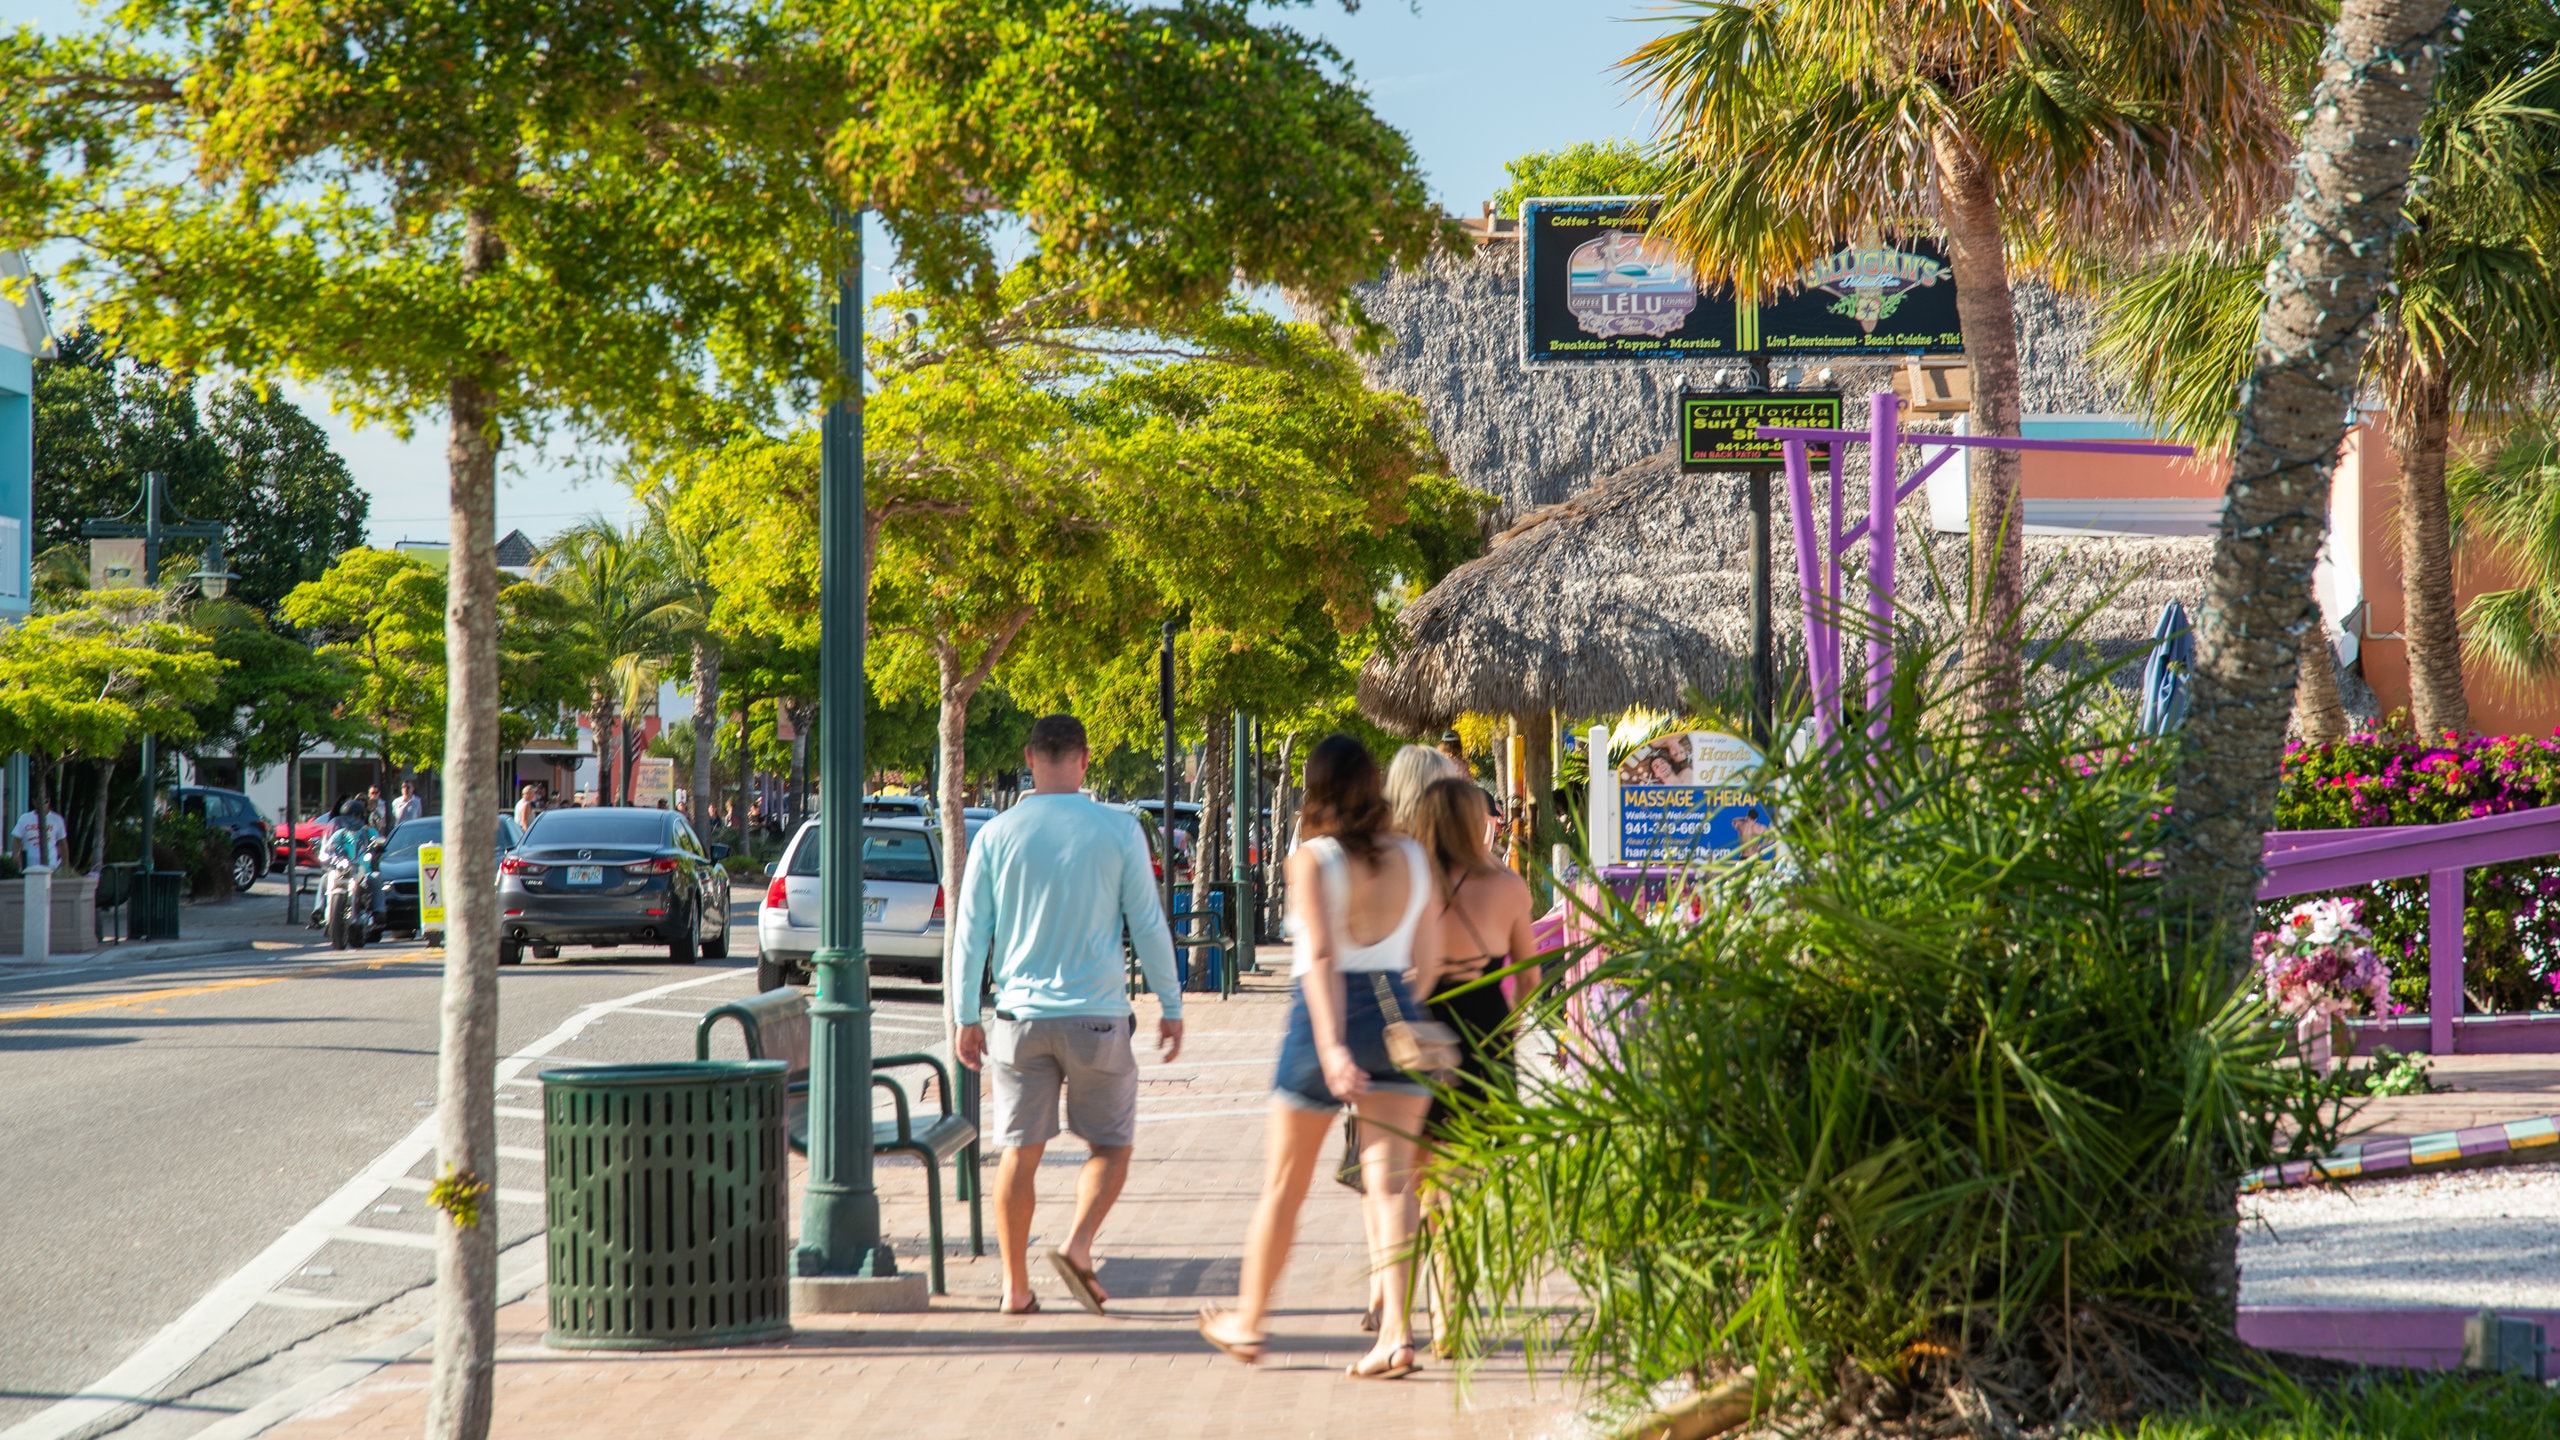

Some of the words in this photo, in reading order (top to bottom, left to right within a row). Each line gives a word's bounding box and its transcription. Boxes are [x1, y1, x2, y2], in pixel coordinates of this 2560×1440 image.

[1551, 215, 1589, 227] Coffee
[1601, 292, 1662, 315] LÉLU
[1550, 339, 1607, 351] Breakfast
[1616, 339, 1661, 352] Tappas
[1669, 337, 1721, 349] Martinis
[1766, 335, 1788, 347] Live
[1788, 334, 1857, 347] Entertainment
[1864, 333, 1895, 347] Beach
[1895, 332, 1933, 346] Cuisine
[1939, 331, 1961, 345] Tiki
[1693, 404, 1830, 418] CaliFlorida
[1693, 417, 1738, 429] Surf
[1768, 417, 1831, 429] Skate
[1699, 746, 1752, 761] Hands
[1699, 765, 1717, 783] of
[1624, 789, 1695, 807] MASSAGE
